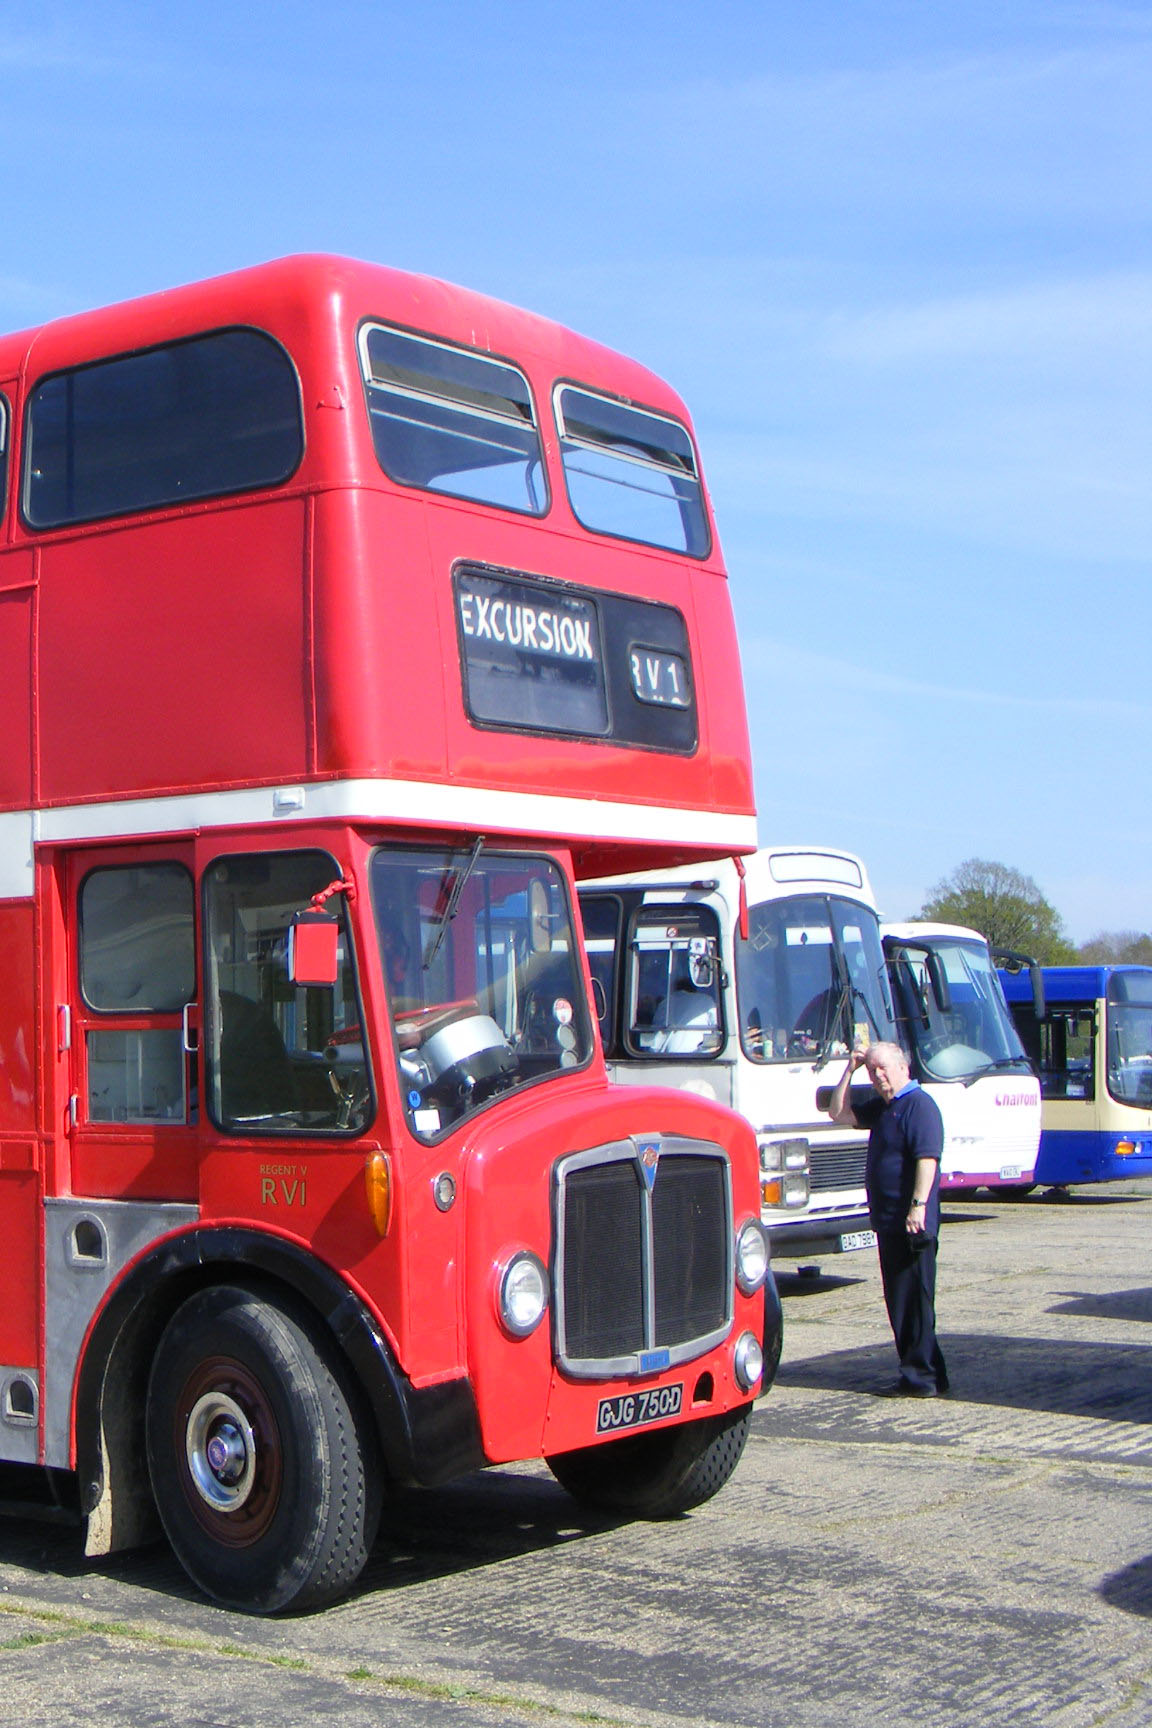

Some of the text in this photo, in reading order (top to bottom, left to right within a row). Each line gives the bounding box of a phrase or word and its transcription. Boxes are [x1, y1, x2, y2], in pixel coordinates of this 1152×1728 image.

[460, 593, 593, 659] EXCURSION
[260, 1164, 308, 1176] REGENT V
[600, 1386, 681, 1428] GJG 750D
